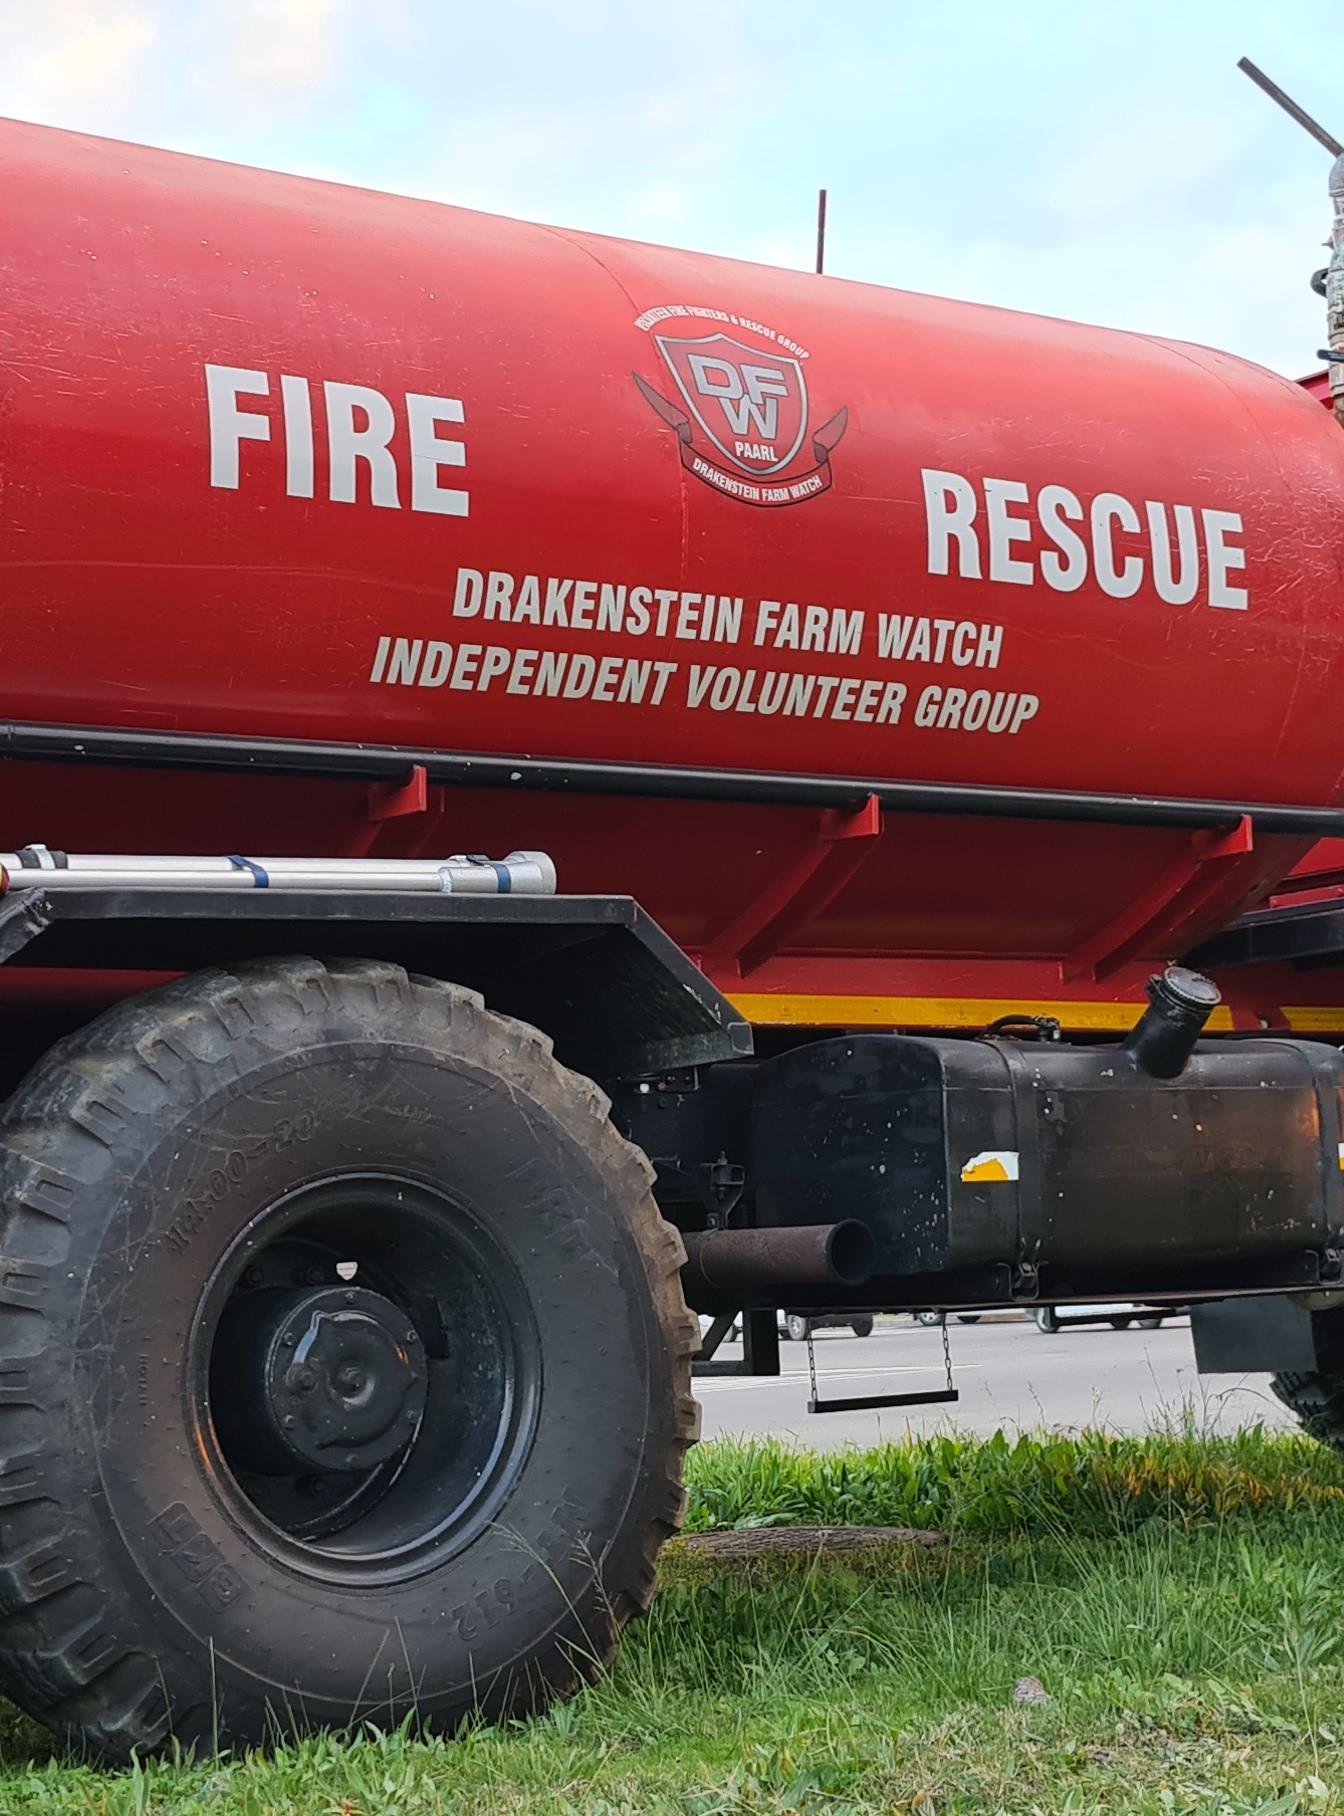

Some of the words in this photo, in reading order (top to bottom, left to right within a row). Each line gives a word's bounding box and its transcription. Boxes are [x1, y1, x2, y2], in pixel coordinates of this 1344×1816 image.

[738, 316, 777, 341] RESCUE
[777, 334, 810, 359] GROUP
[692, 457, 760, 501] DRAKENSTEIN
[761, 486, 790, 502] FARM
[789, 474, 823, 499] WATCH
[734, 440, 779, 462] PAARL
[204, 363, 469, 517] FIRE
[921, 468, 1249, 611] RESCUE
[453, 568, 744, 644] DRAKENSTEIN
[754, 601, 865, 655] FARM
[878, 613, 1003, 669] WATCH
[370, 636, 678, 705] INDEPENDENT
[687, 665, 907, 724] VOLUNTEER
[914, 685, 1039, 734] GROUP
